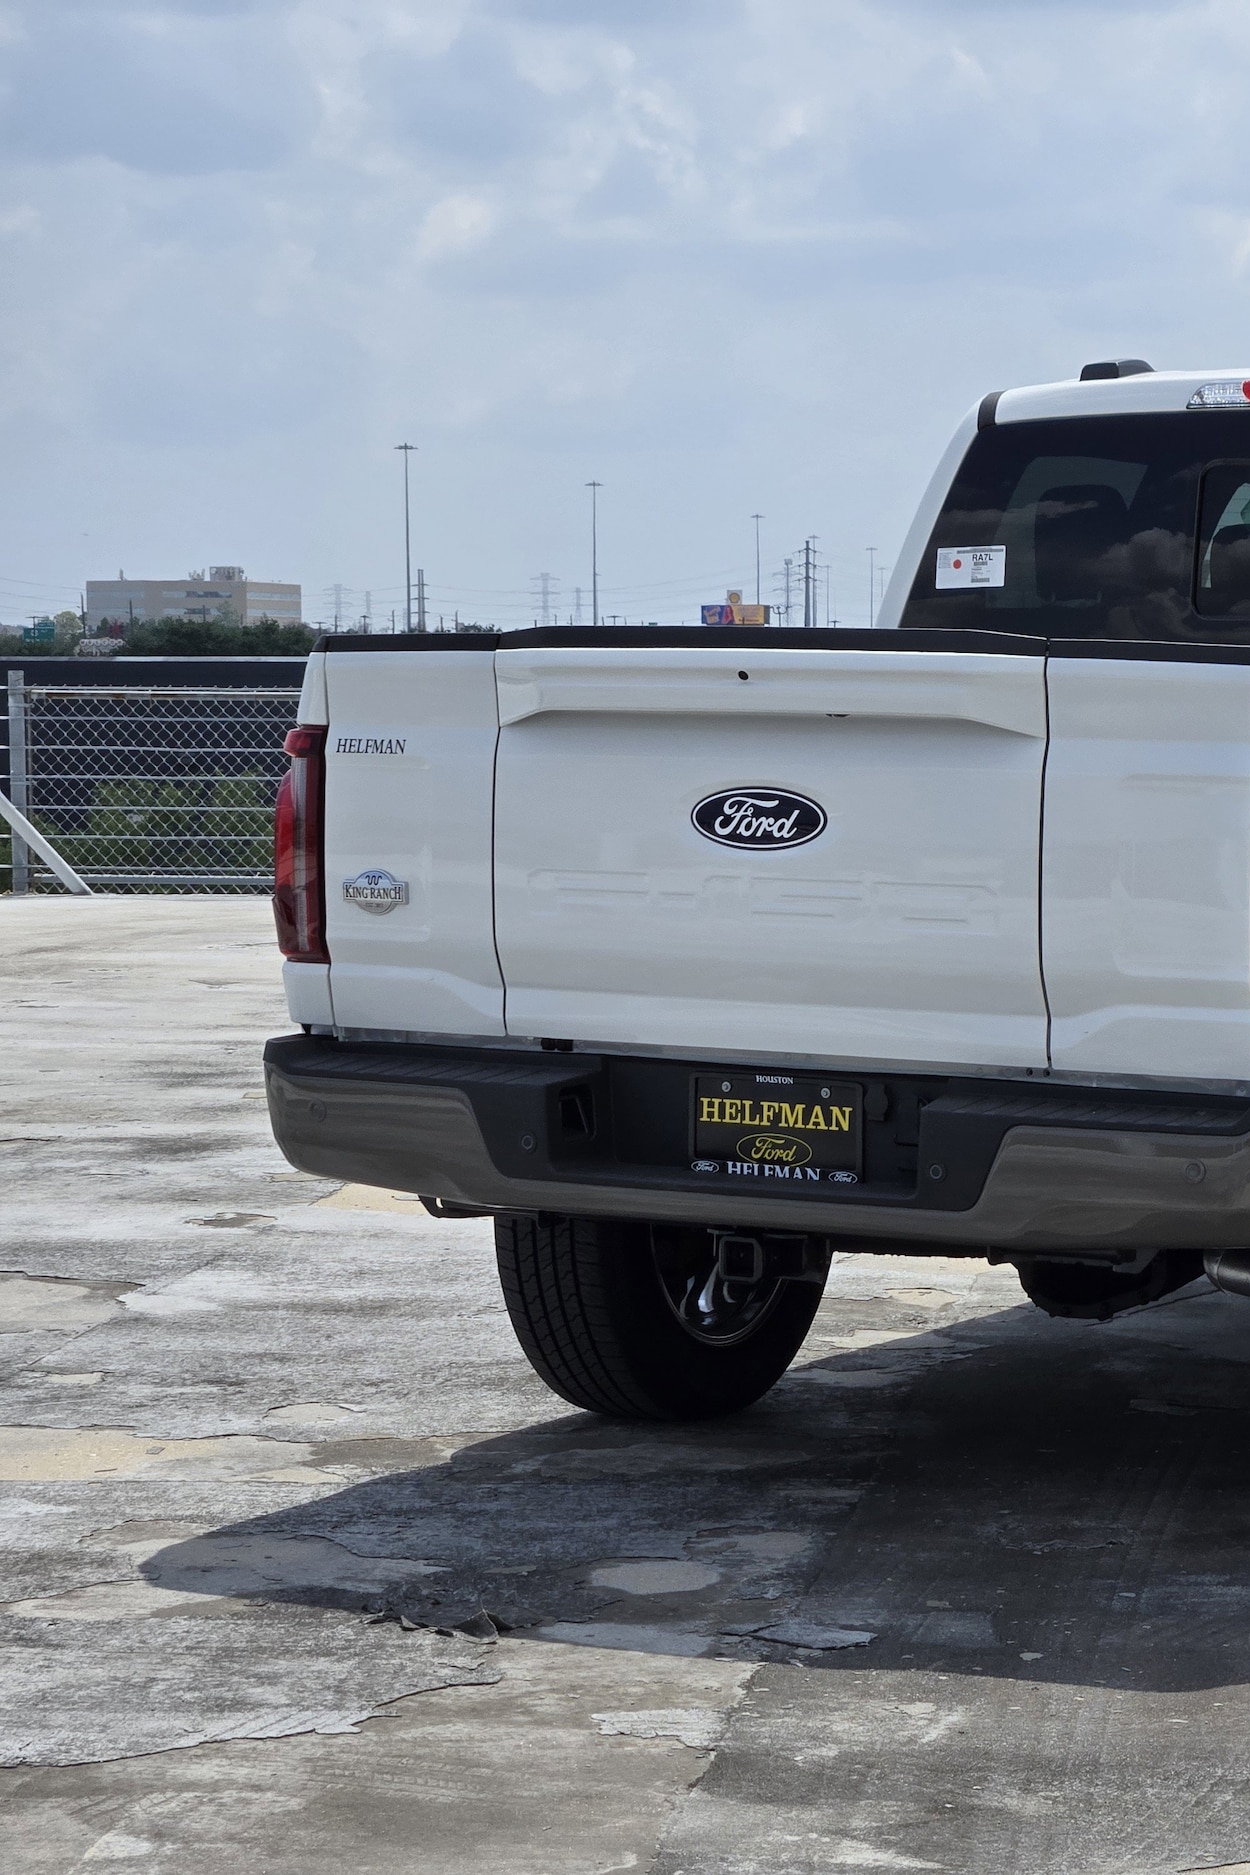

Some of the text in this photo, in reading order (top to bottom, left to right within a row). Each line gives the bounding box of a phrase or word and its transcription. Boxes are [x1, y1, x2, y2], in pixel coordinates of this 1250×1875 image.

[336, 738, 407, 755] HELFMAN
[714, 796, 801, 839] Ford
[344, 884, 402, 901] KING RANCH
[755, 1075, 794, 1085] HOUSTON
[700, 1097, 853, 1131] HELFMAN
[751, 1136, 797, 1162] Ford
